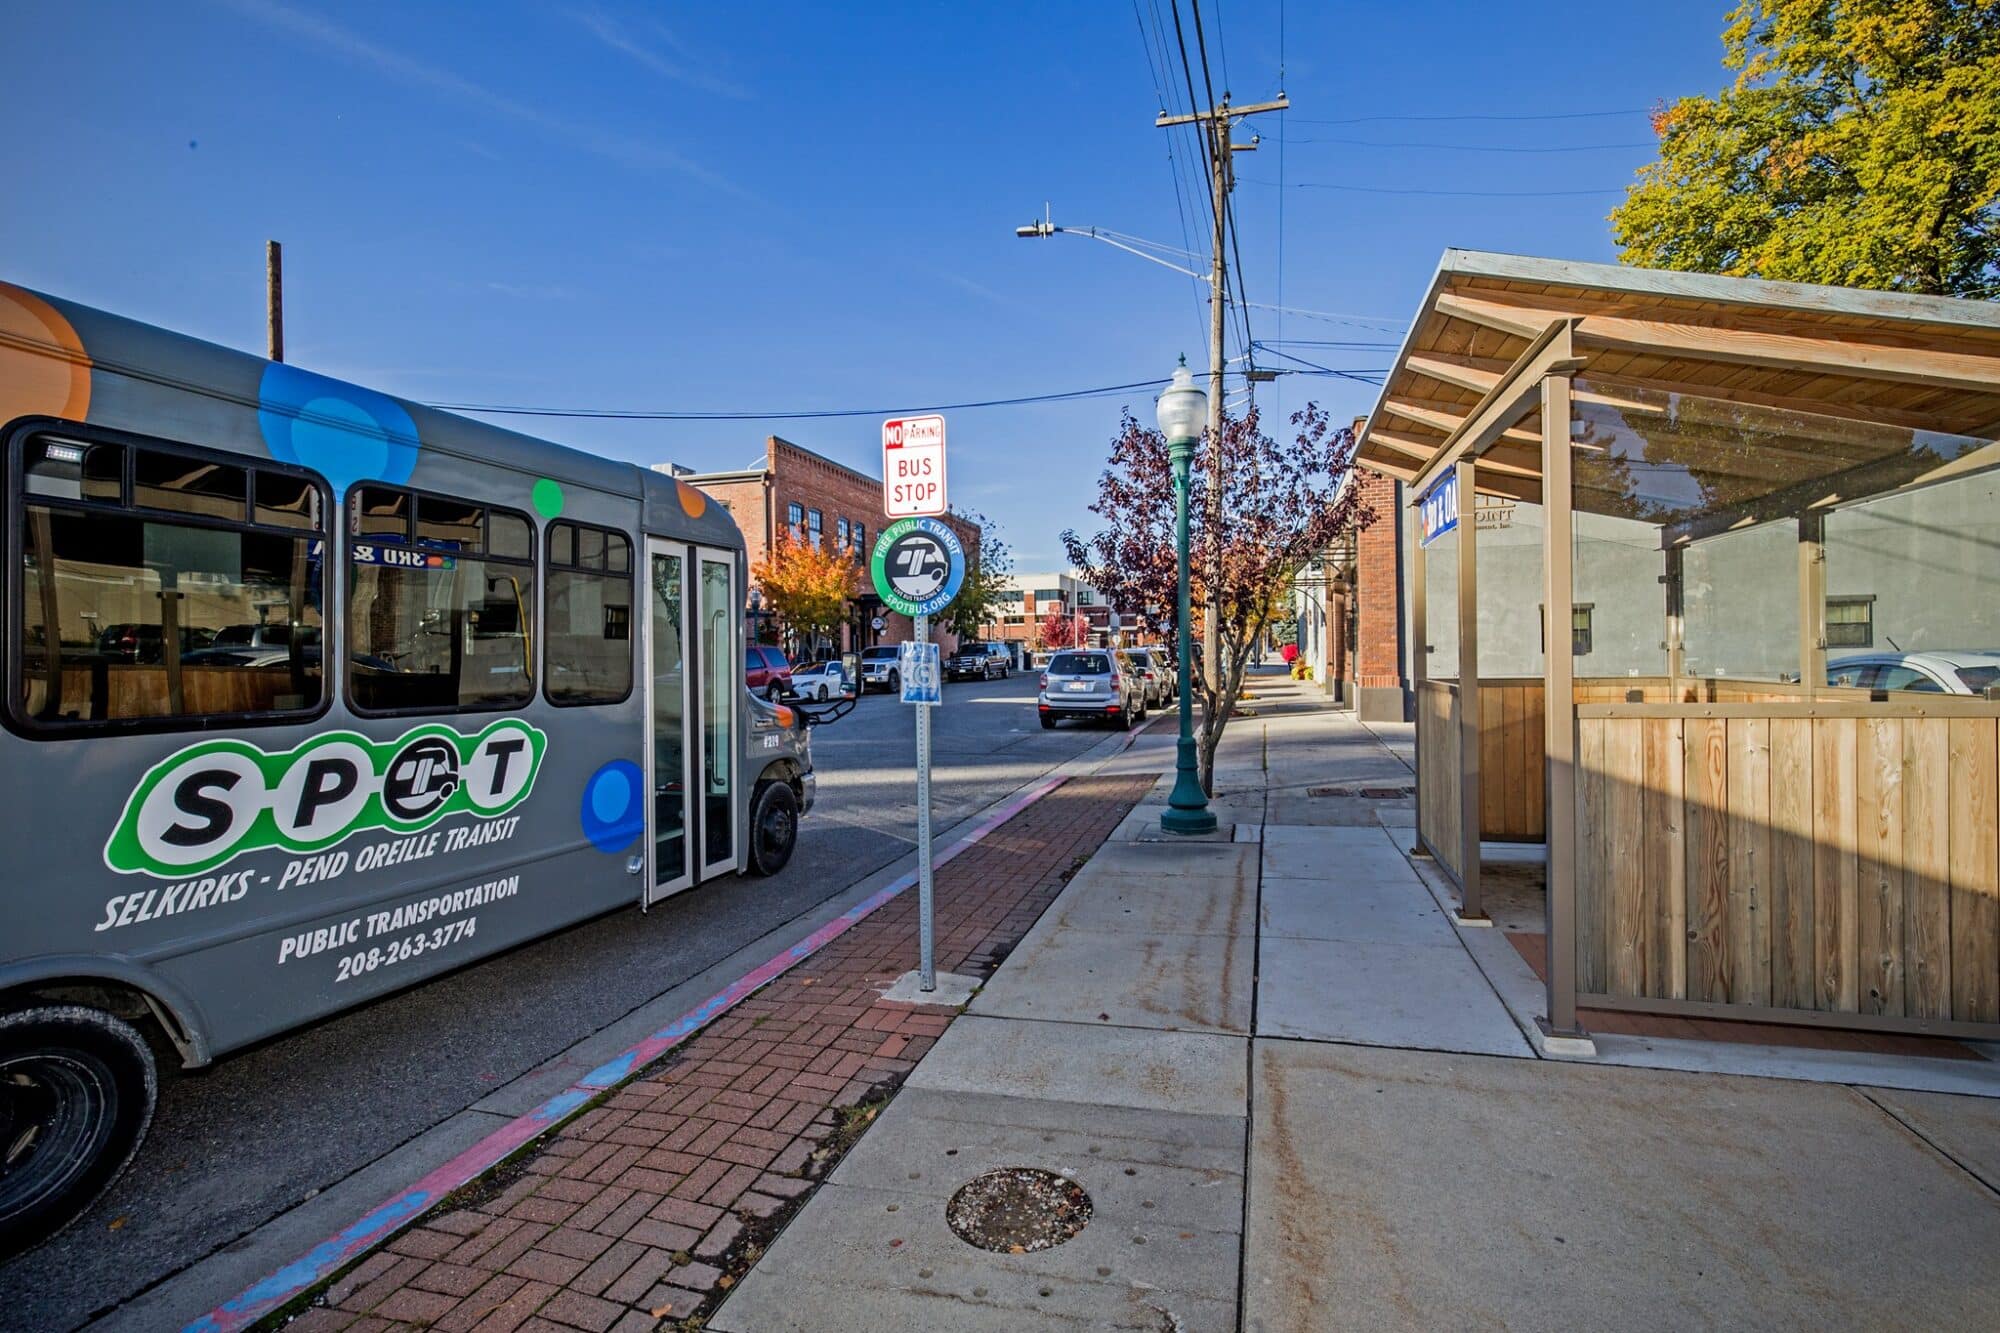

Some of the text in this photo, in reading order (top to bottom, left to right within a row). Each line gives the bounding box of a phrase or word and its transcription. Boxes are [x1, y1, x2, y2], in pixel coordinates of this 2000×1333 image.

[886, 426, 941, 445] NO PARKING
[898, 457, 932, 478] BUS
[894, 482, 937, 503] STOP
[1445, 479, 1457, 524] OA
[1474, 510, 1514, 521] OINT
[876, 519, 961, 559] FREE PUBLIC TRANSIT
[886, 592, 951, 614] SPOTBUS.ORG
[159, 736, 525, 847] SPOT
[94, 869, 255, 932] SELKIRKS
[277, 850, 349, 891] PEND
[354, 832, 441, 873] OREILLE
[443, 815, 521, 853] TRANSIT
[277, 875, 520, 964] PUBLIC TRANSPORTATION
[335, 917, 477, 982] 208-263-3774
